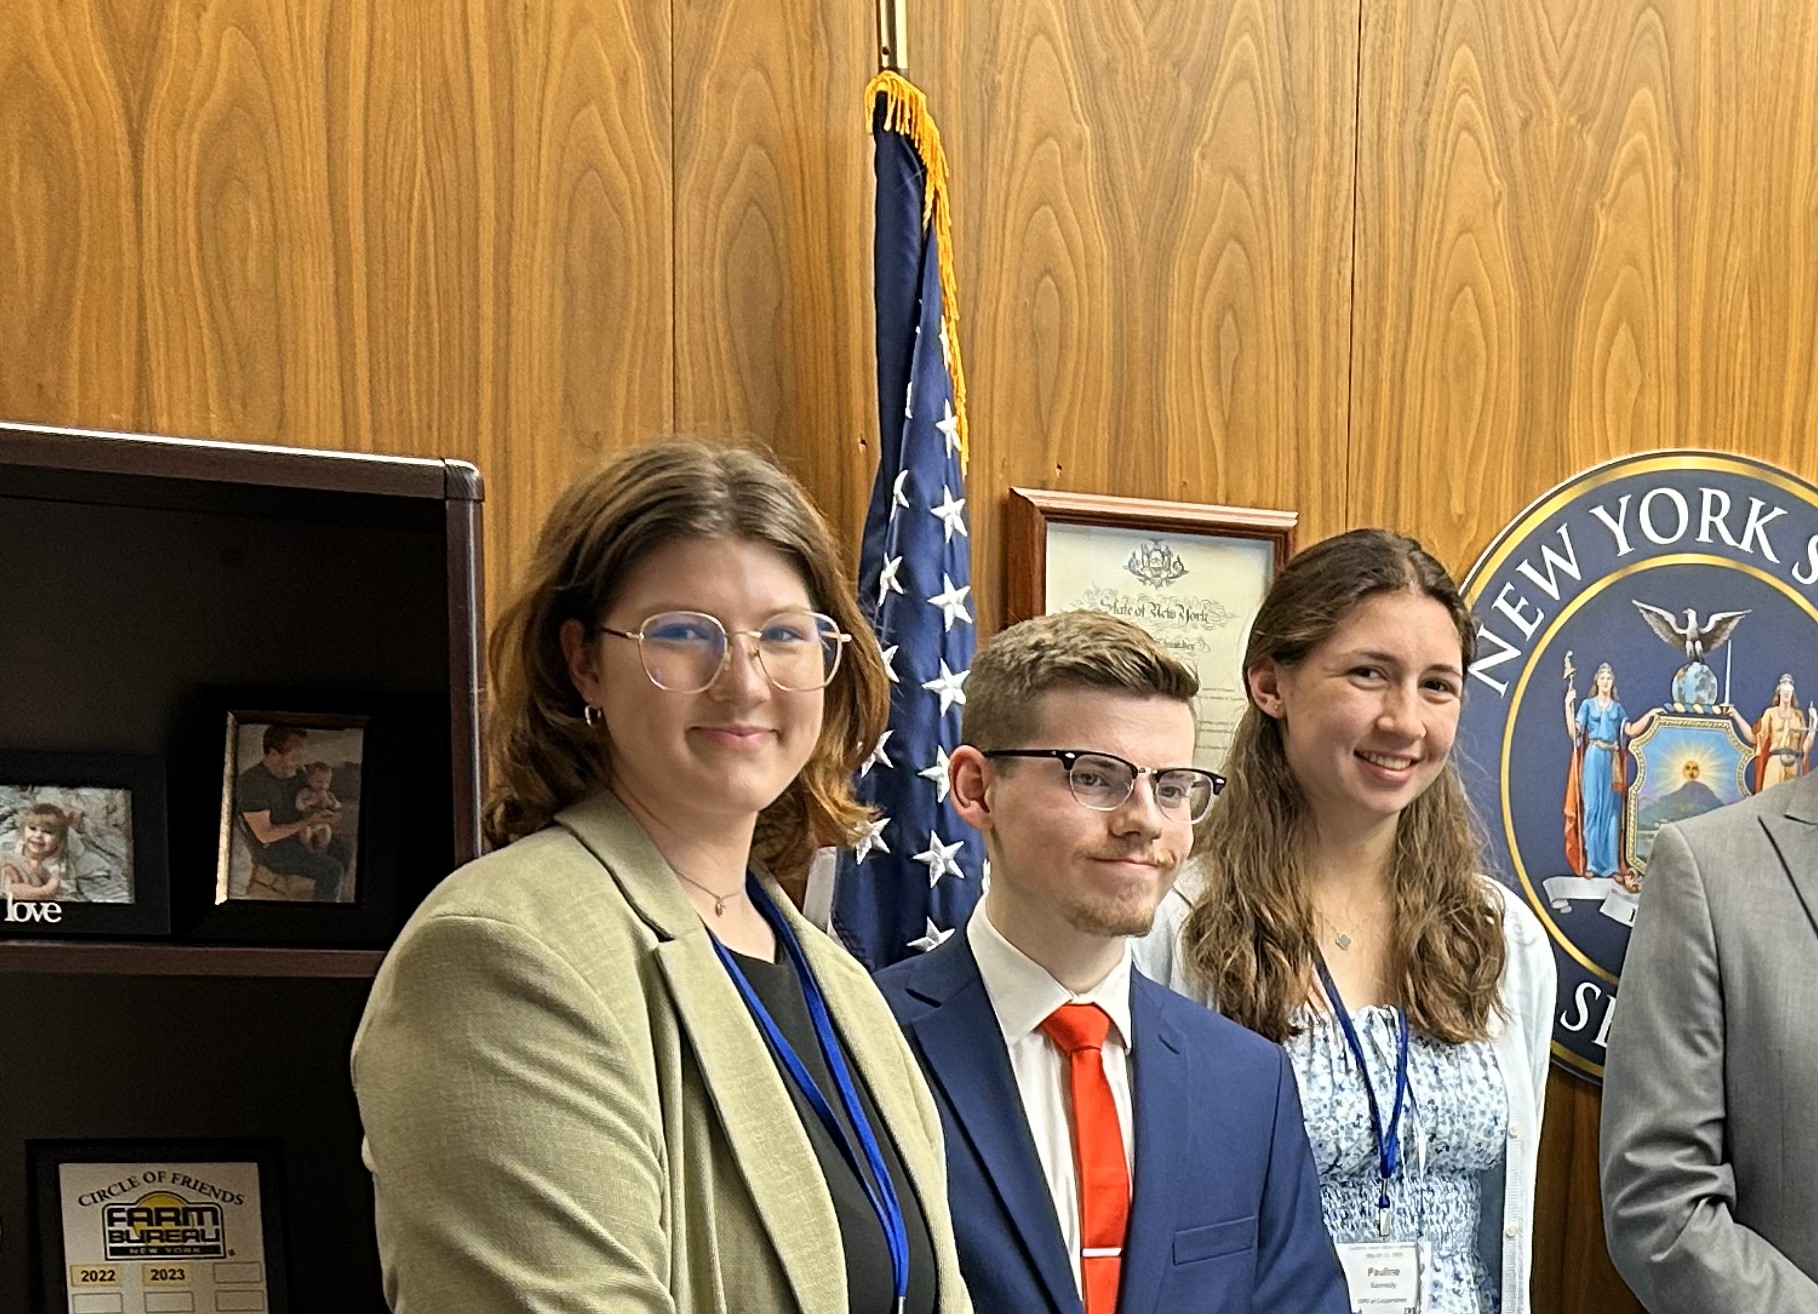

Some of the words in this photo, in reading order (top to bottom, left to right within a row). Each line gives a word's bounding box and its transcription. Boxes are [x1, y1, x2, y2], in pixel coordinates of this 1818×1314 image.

[1468, 521, 1583, 698] NEW
[1590, 487, 1787, 564] YORK
[4, 893, 63, 924] love
[78, 1175, 140, 1208] CIRCLE
[142, 1170, 166, 1185] OF
[170, 1172, 245, 1206] FRIENDS
[107, 1207, 219, 1227] FARM
[108, 1228, 220, 1244] BUREAU
[129, 1248, 158, 1256] NEW
[166, 1246, 201, 1255] YORK
[80, 1270, 116, 1282] 2022
[150, 1269, 185, 1281] 2023
